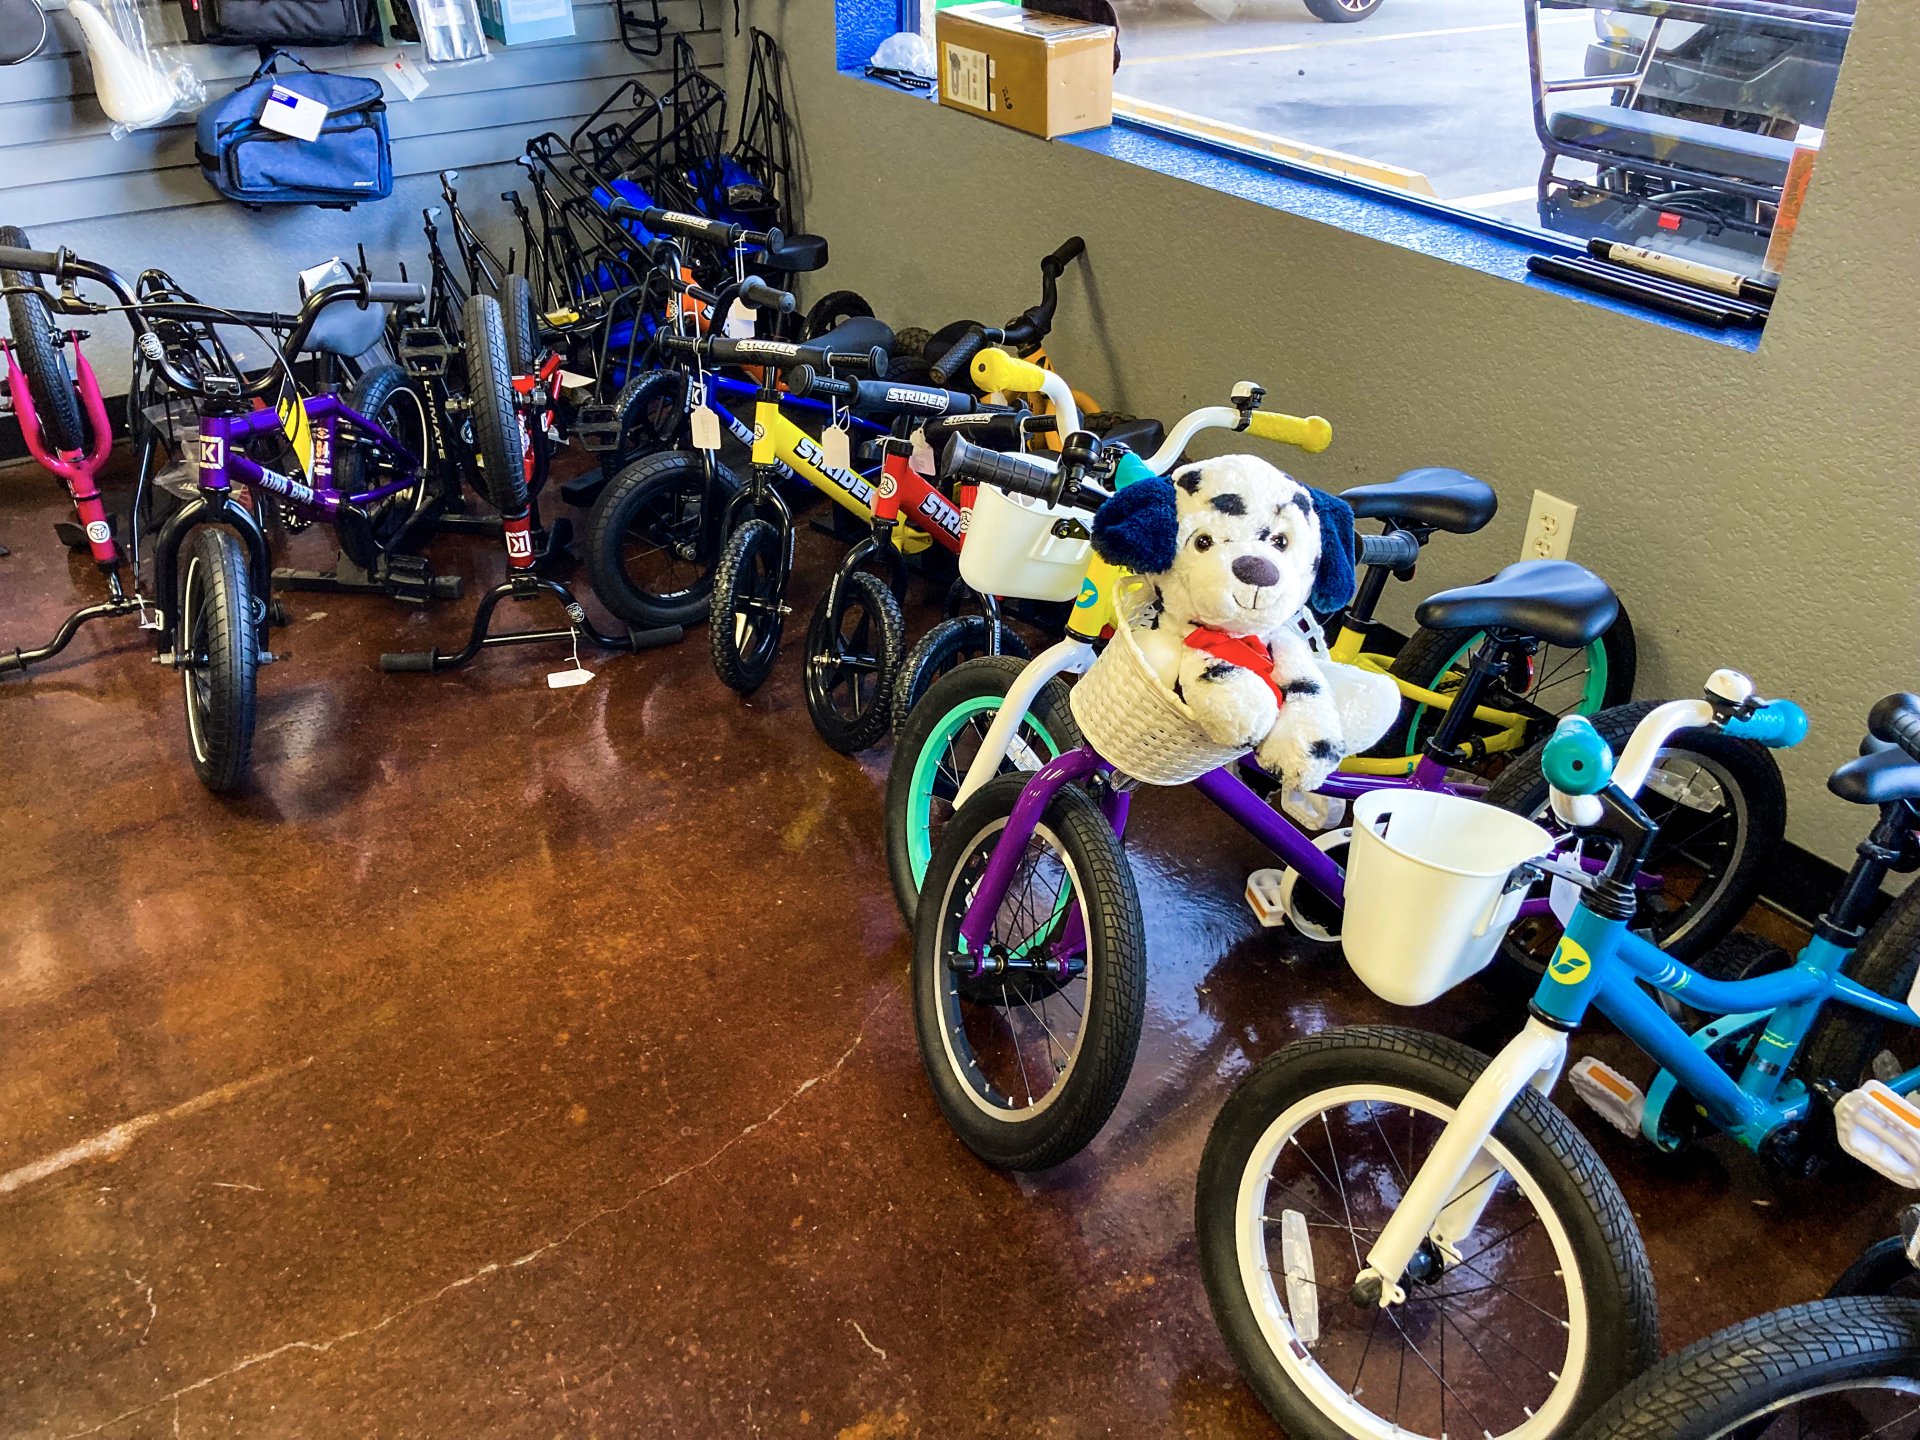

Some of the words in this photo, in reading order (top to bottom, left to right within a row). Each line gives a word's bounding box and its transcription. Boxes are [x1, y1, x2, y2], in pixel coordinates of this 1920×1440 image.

[661, 210, 713, 230] STRIDER
[735, 339, 801, 357] STRIDER
[885, 387, 949, 410] STRIDER
[942, 412, 995, 426] STRIDER
